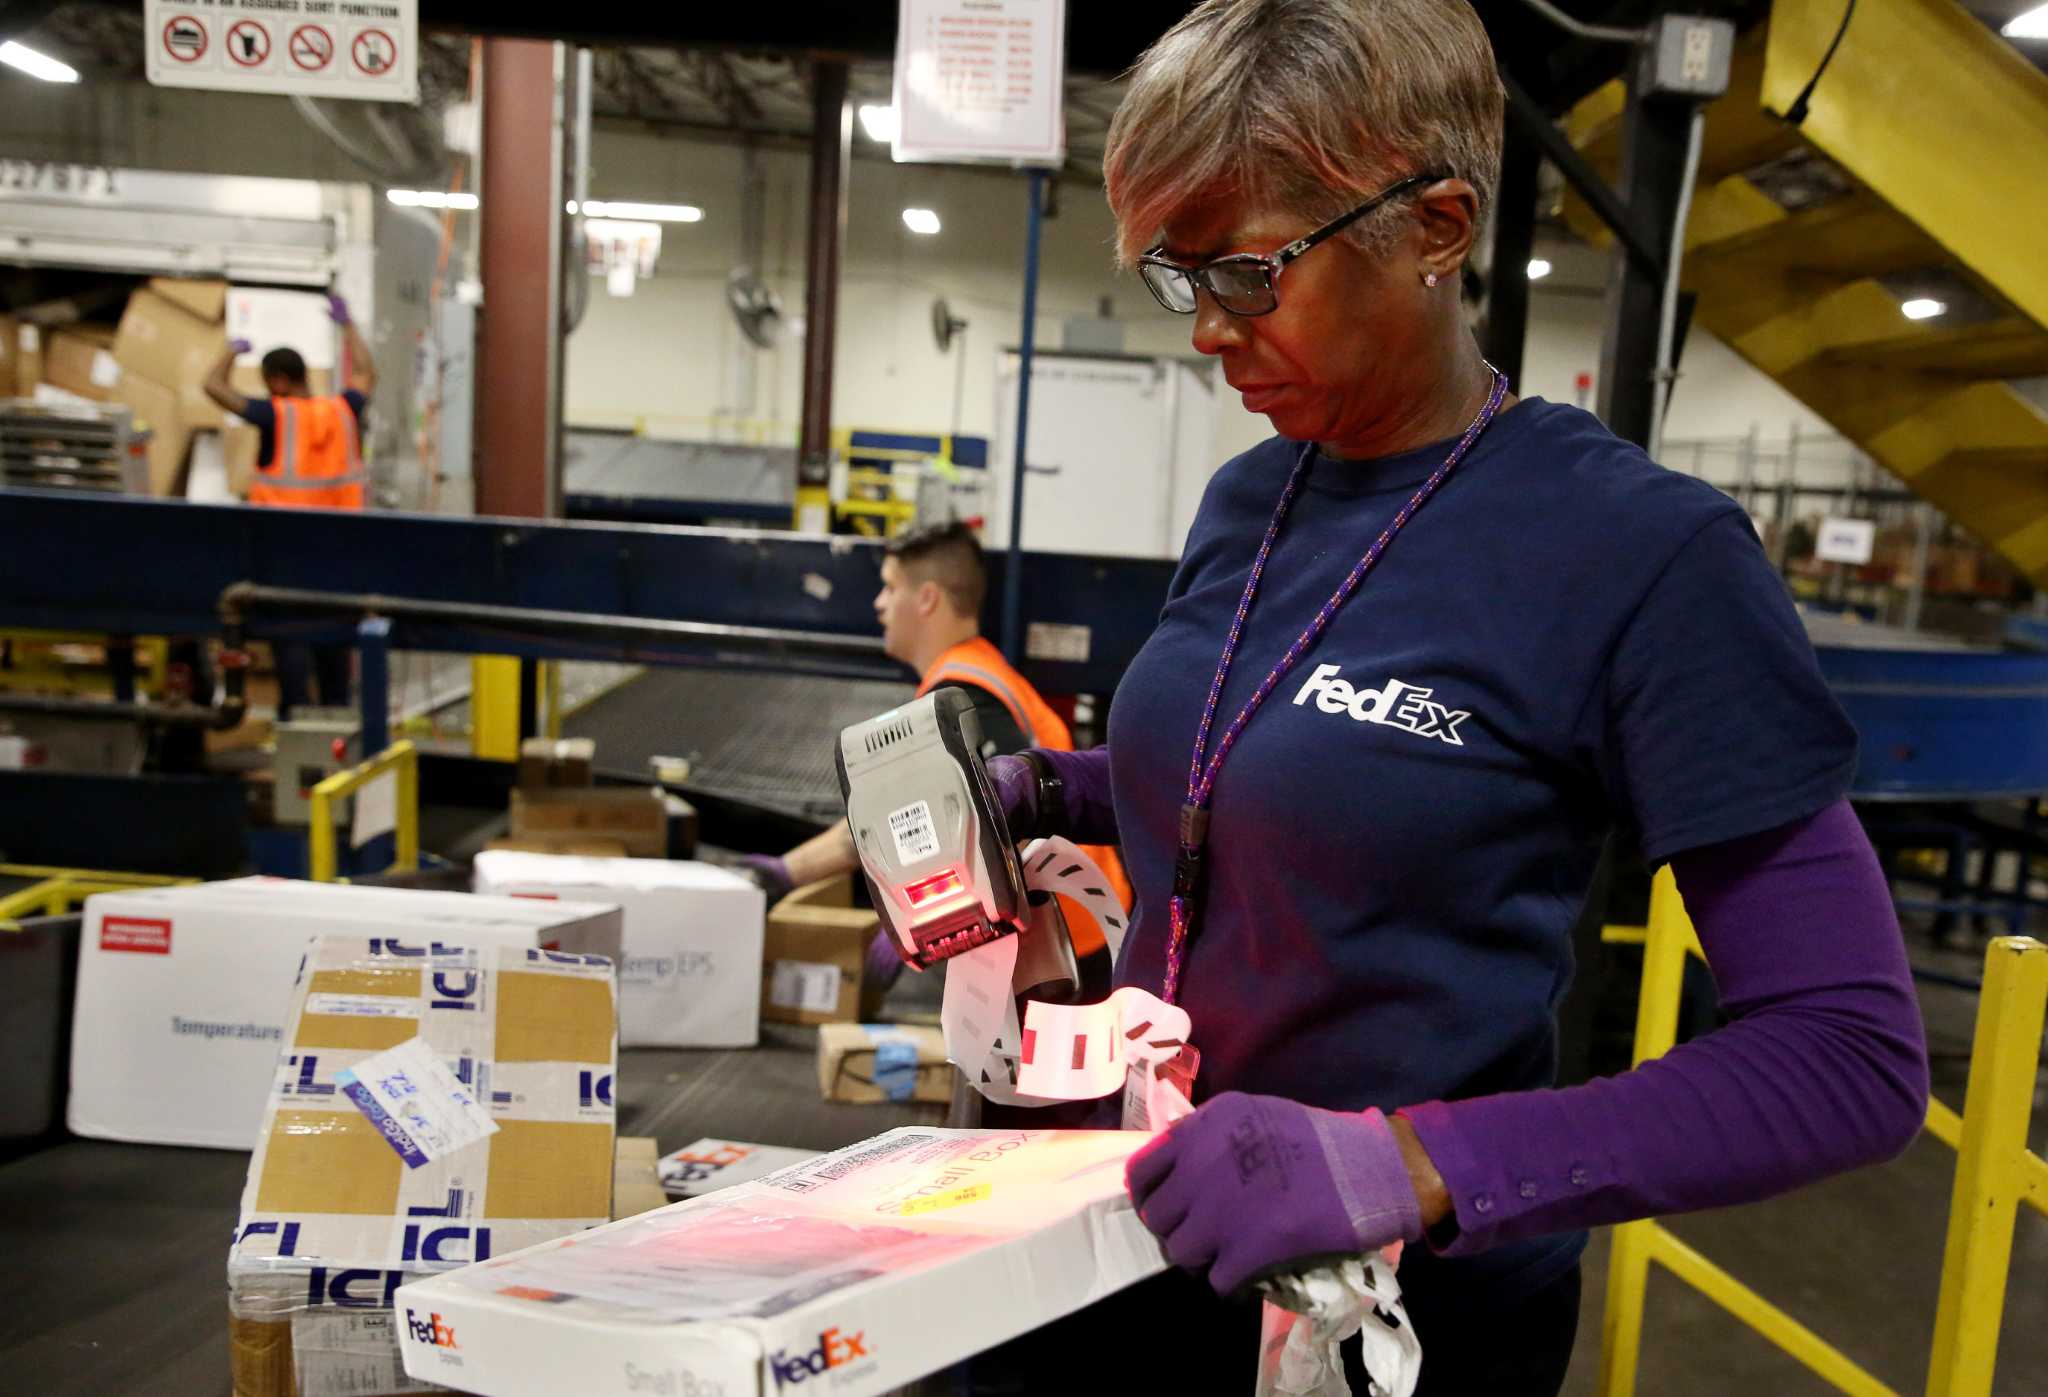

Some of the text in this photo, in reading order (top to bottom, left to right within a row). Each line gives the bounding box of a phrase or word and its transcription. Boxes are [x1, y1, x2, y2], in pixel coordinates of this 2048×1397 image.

[1292, 663, 1473, 746] FedEx
[172, 1016, 285, 1041] Temperature
[968, 1131, 1041, 1163] Box
[406, 1308, 456, 1349] FedEx
[769, 1324, 869, 1395] FedEx
[624, 1361, 726, 1397] Small Box
